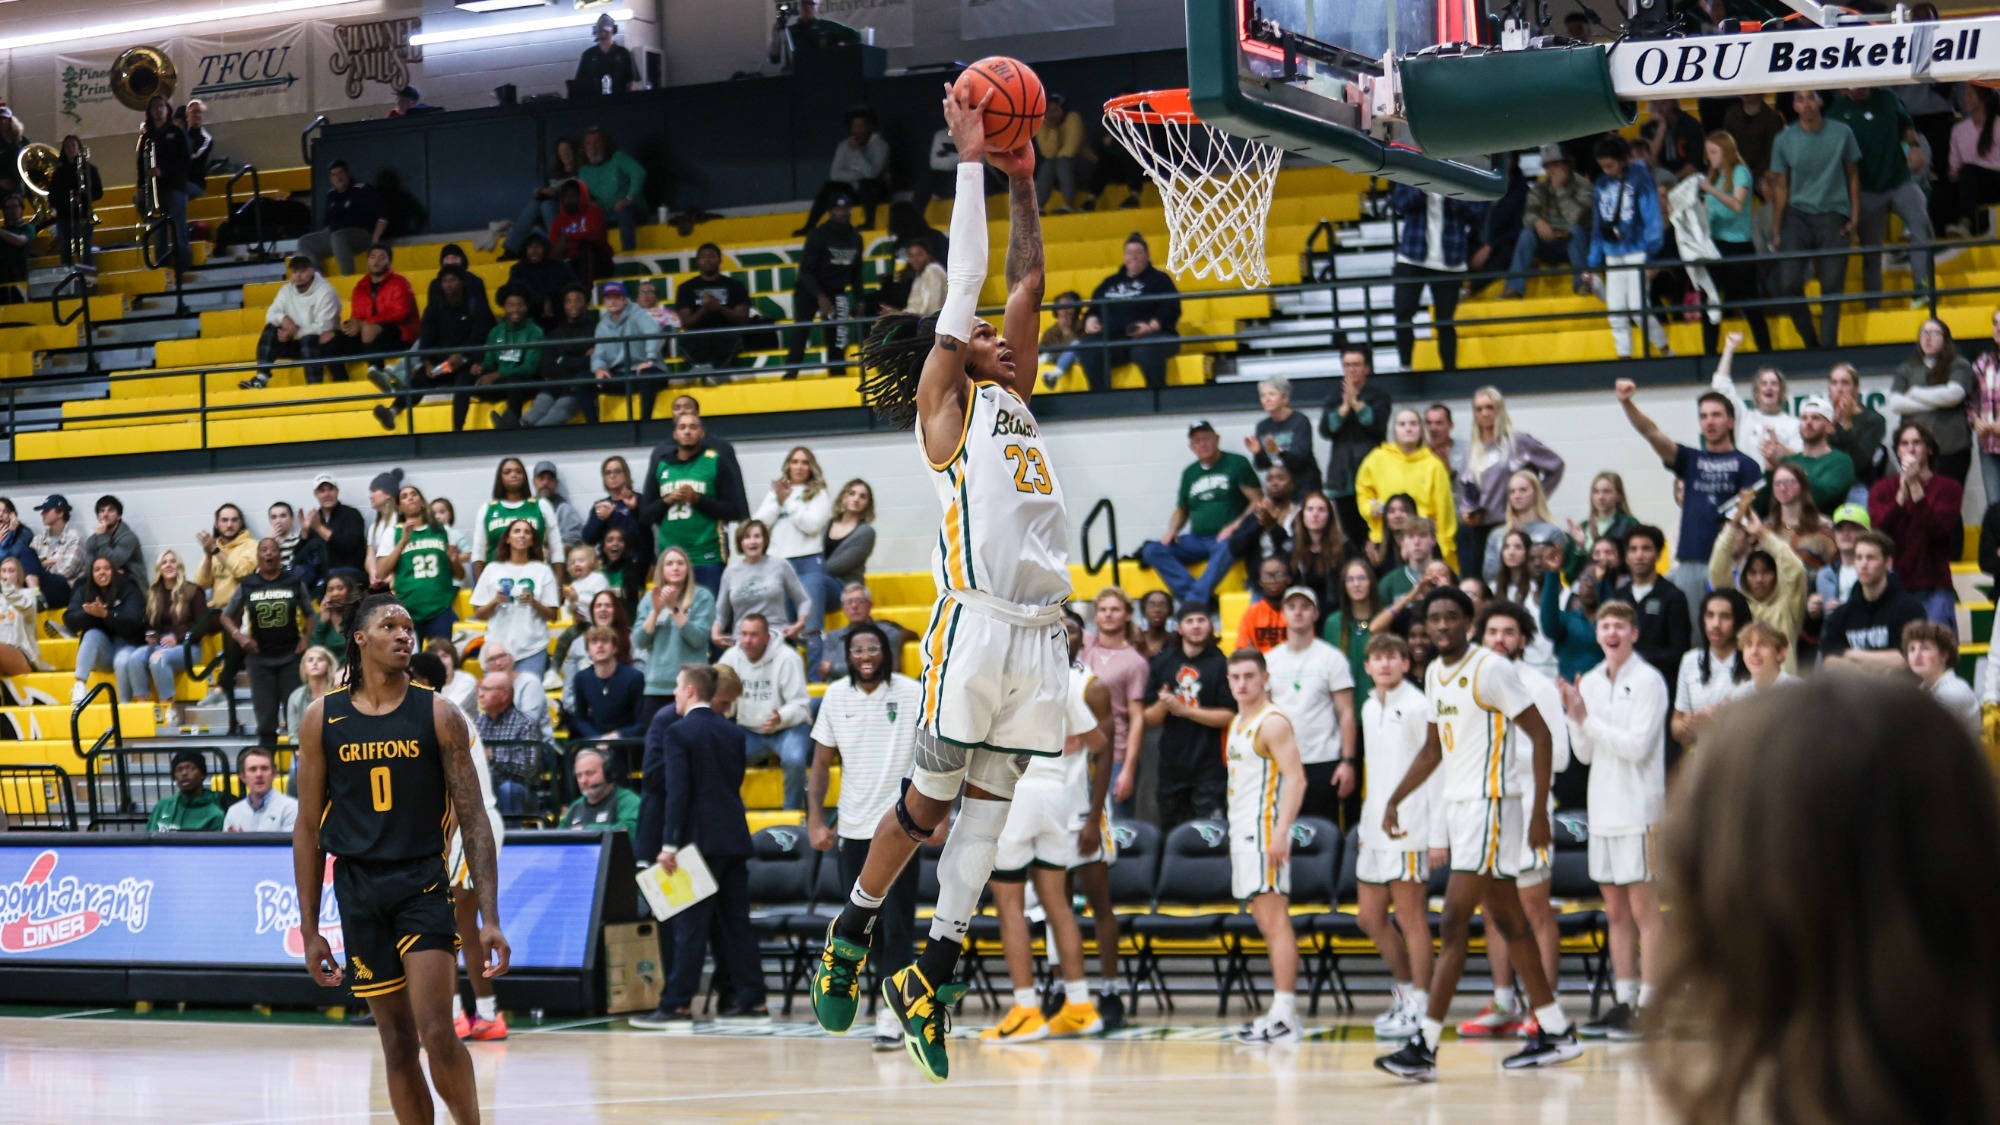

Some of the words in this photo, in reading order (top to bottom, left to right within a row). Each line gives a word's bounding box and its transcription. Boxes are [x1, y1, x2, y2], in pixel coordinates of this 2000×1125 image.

[198, 46, 290, 86] TFCU
[1635, 41, 1752, 86] OBU
[1768, 28, 1981, 73] Basketall
[1003, 444, 1053, 495] 23
[412, 553, 439, 579] 23
[255, 601, 288, 628] 23
[339, 739, 420, 762] GRIFFONS
[370, 766, 392, 812] 0
[23, 915, 86, 948] DINER
